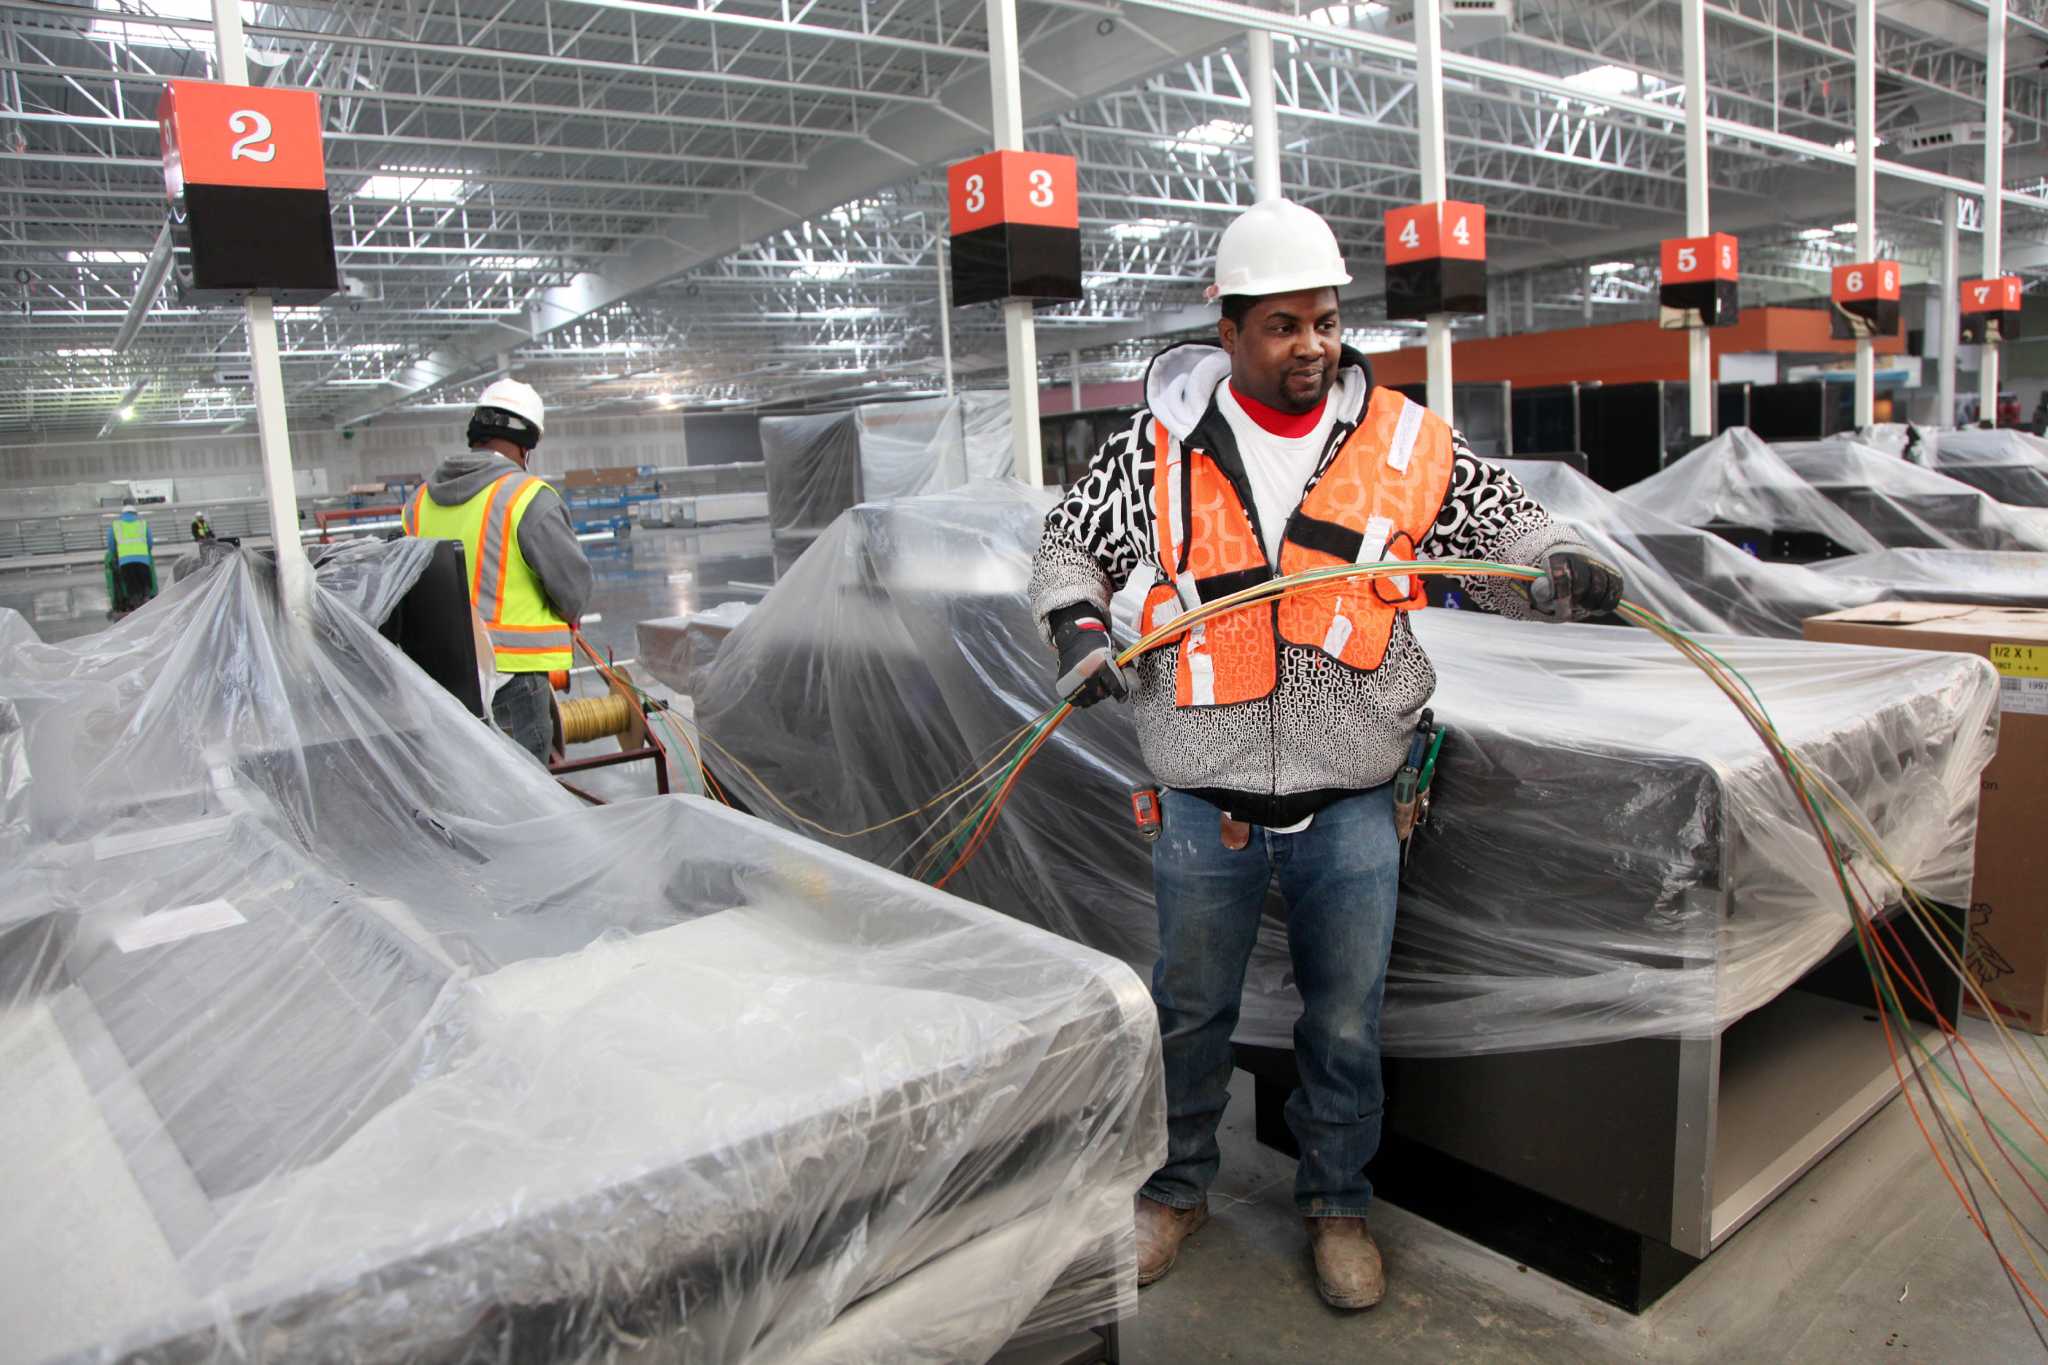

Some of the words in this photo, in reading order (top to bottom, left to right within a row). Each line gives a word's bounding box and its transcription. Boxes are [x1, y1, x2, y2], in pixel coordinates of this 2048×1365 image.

[229, 109, 276, 162] 2
[965, 174, 985, 213] 3
[1029, 169, 1055, 208] 3
[1399, 218, 1420, 248] 4
[1452, 215, 1470, 245] 4
[1677, 247, 1697, 273] 5
[1722, 245, 1732, 270] 5
[1846, 271, 1865, 293] 6
[1884, 270, 1894, 292] 6
[2007, 284, 2016, 303] 7
[1973, 286, 1990, 305] 7
[2014, 647, 2022, 658] X
